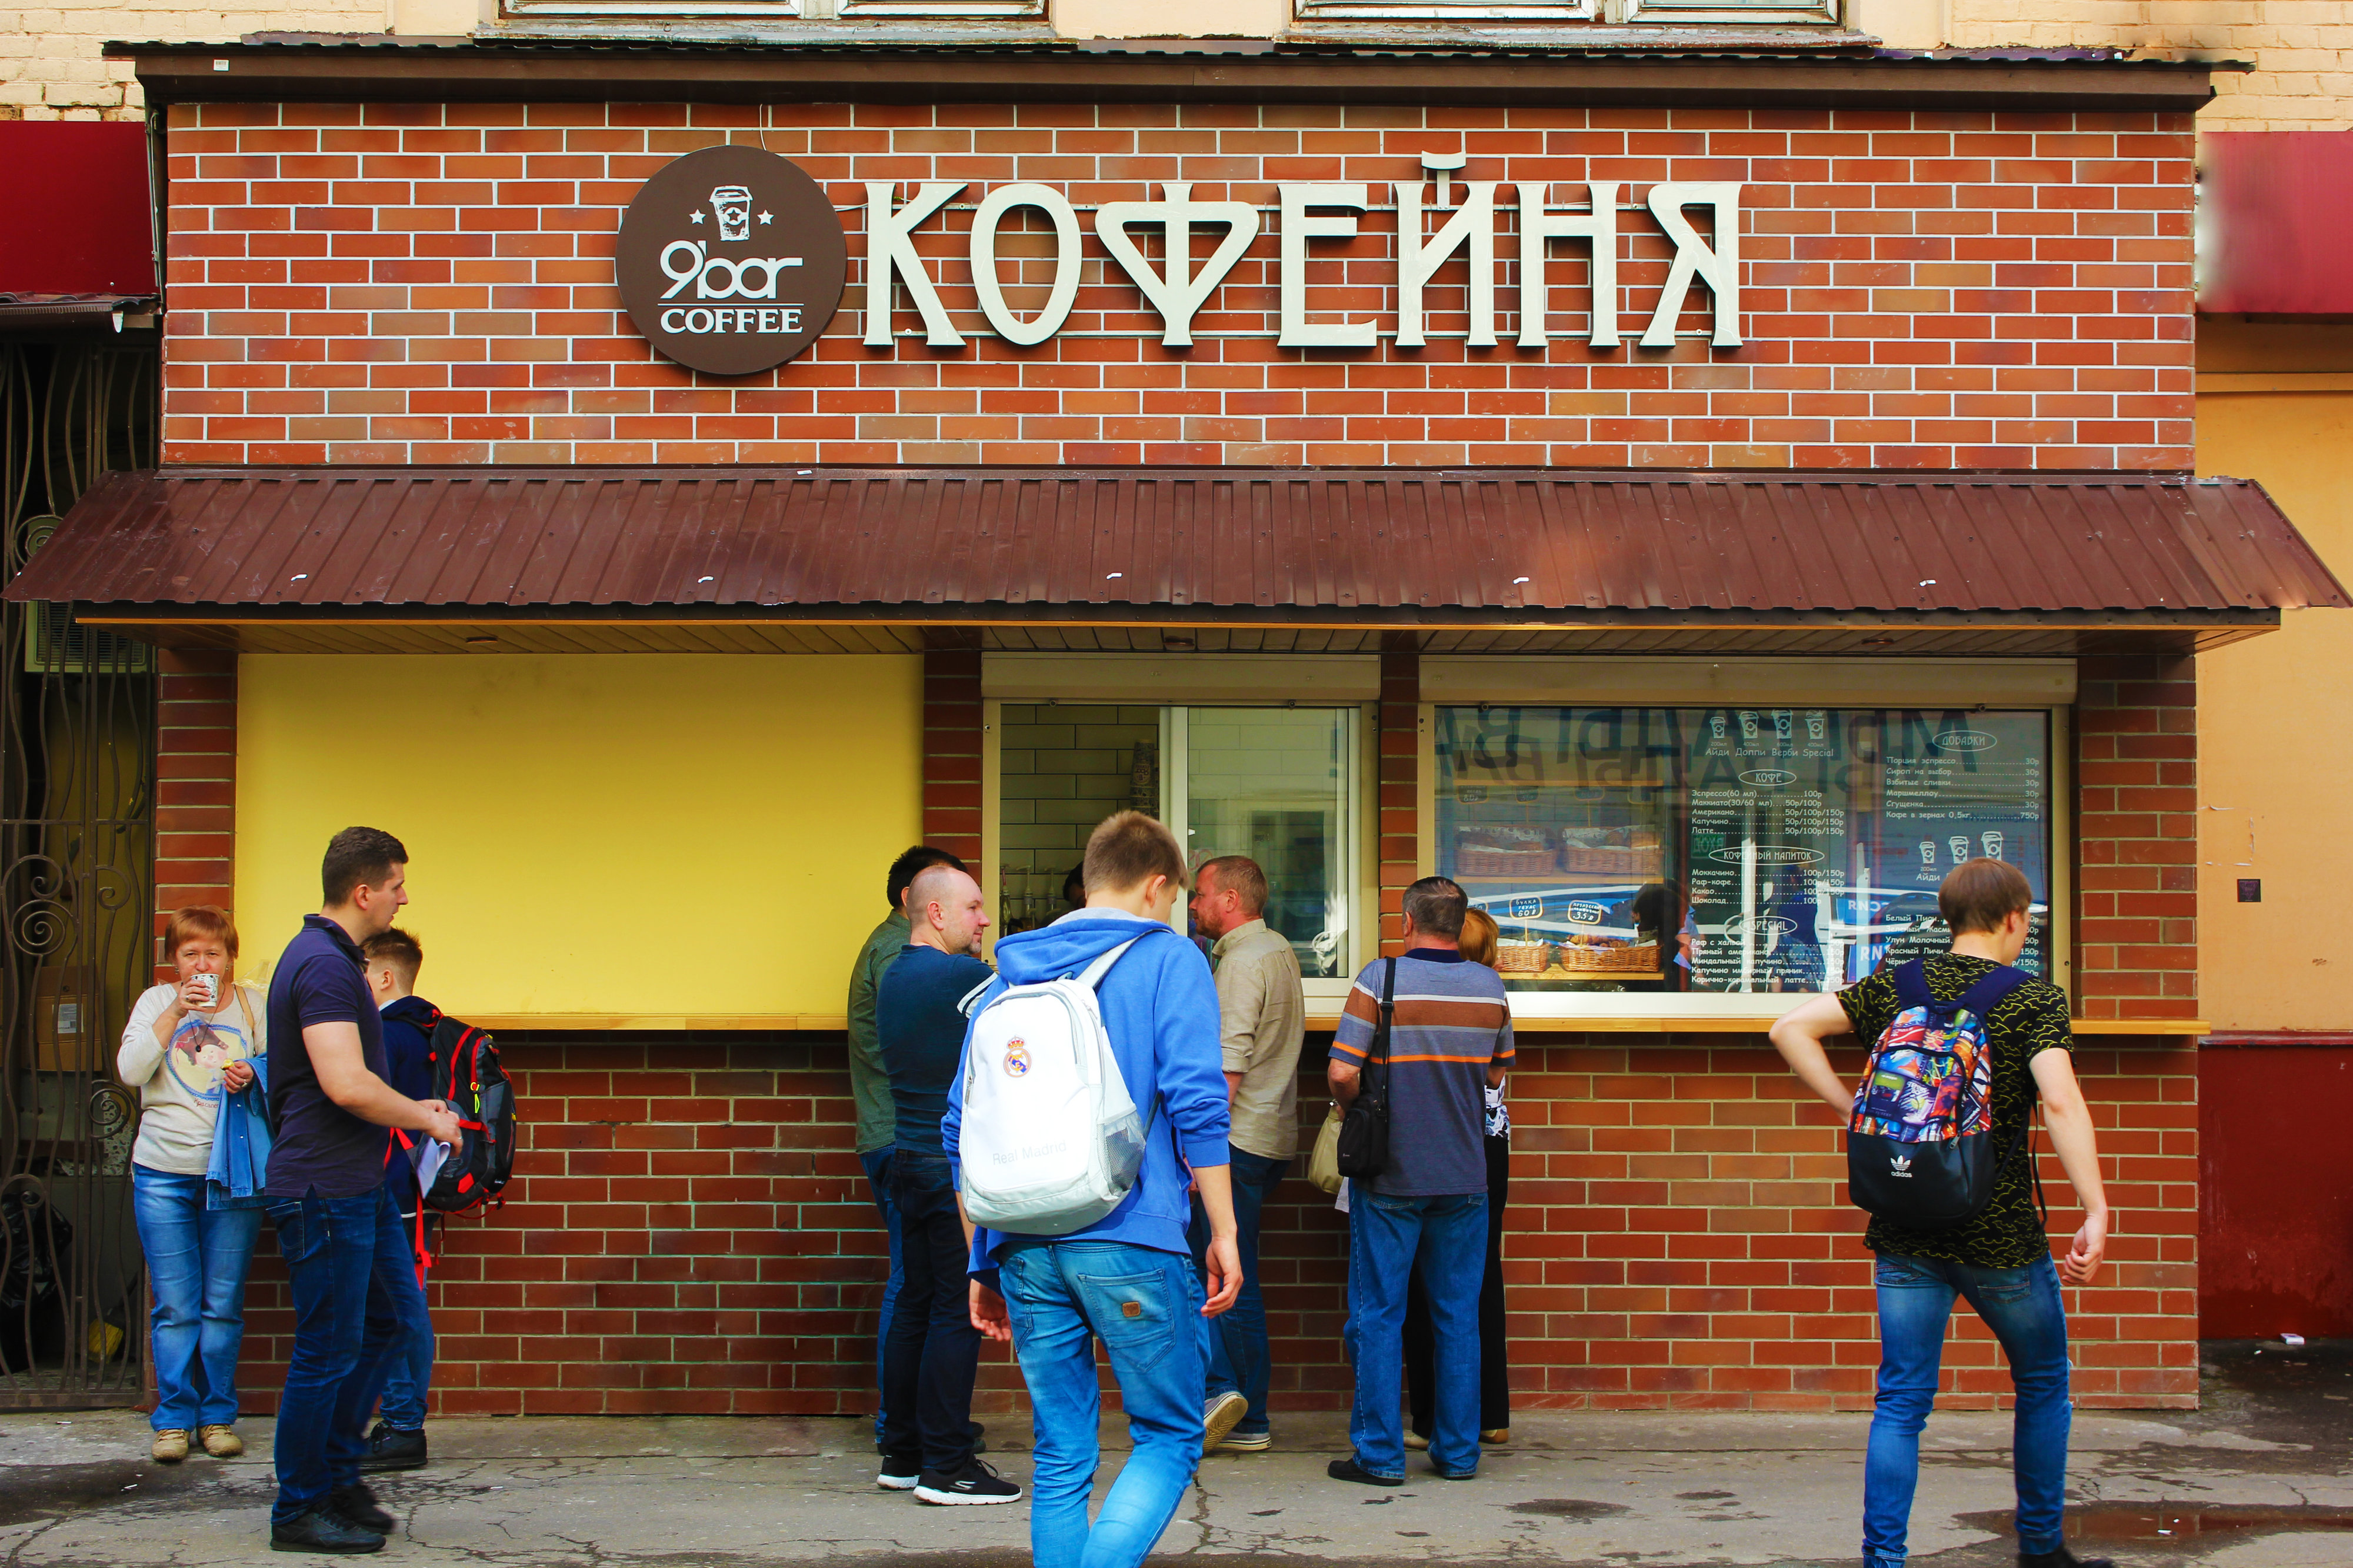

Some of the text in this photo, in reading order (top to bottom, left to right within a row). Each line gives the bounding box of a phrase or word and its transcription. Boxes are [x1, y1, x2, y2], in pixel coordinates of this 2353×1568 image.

[863, 151, 1743, 348] КОФЕЙНЯ
[660, 307, 804, 334] COFFEE
[1942, 736, 1985, 746] ДОБАВКИ
[1706, 748, 1729, 757] Айди
[1735, 748, 1765, 757] Доппи
[1771, 748, 1798, 757] Верби
[1802, 748, 1834, 759] Special
[1886, 757, 1916, 765] Порция
[2025, 758, 2039, 766] 30р
[1755, 772, 1782, 782] КОФЕ
[1886, 768, 1911, 776] Сироп
[1928, 768, 1952, 776] выбор
[2025, 769, 2039, 777] 30р
[2025, 779, 2039, 788] 30р
[1804, 790, 1822, 799] 100р
[1886, 789, 2039, 799] Маршмеллоу 30р
[1886, 800, 2039, 809] Сгущенка 30р
[1692, 809, 1734, 818] Американо
[1886, 811, 1907, 820] Кофе
[2020, 812, 2039, 820] 750р
[1692, 818, 1729, 827] Капучино
[1774, 850, 1812, 860] НАПИТОК
[1916, 873, 1940, 882] Айди
[1692, 879, 1731, 887] Раф-кофе
[1751, 920, 1788, 930] SPECIAL
[1691, 938, 1707, 947] Раф
[1718, 938, 1746, 946] халвой
[1885, 936, 1905, 945] Улун
[1691, 948, 1722, 957] Пряный
[1885, 947, 1919, 956] Красный
[1691, 958, 1741, 966] Миндальный
[1746, 958, 1782, 966] капучино
[1691, 967, 1729, 975] Капучино
[1732, 967, 1772, 975] имбирный
[1776, 968, 1802, 976] пряник
[992, 1140, 1066, 1165] Real Madrid
